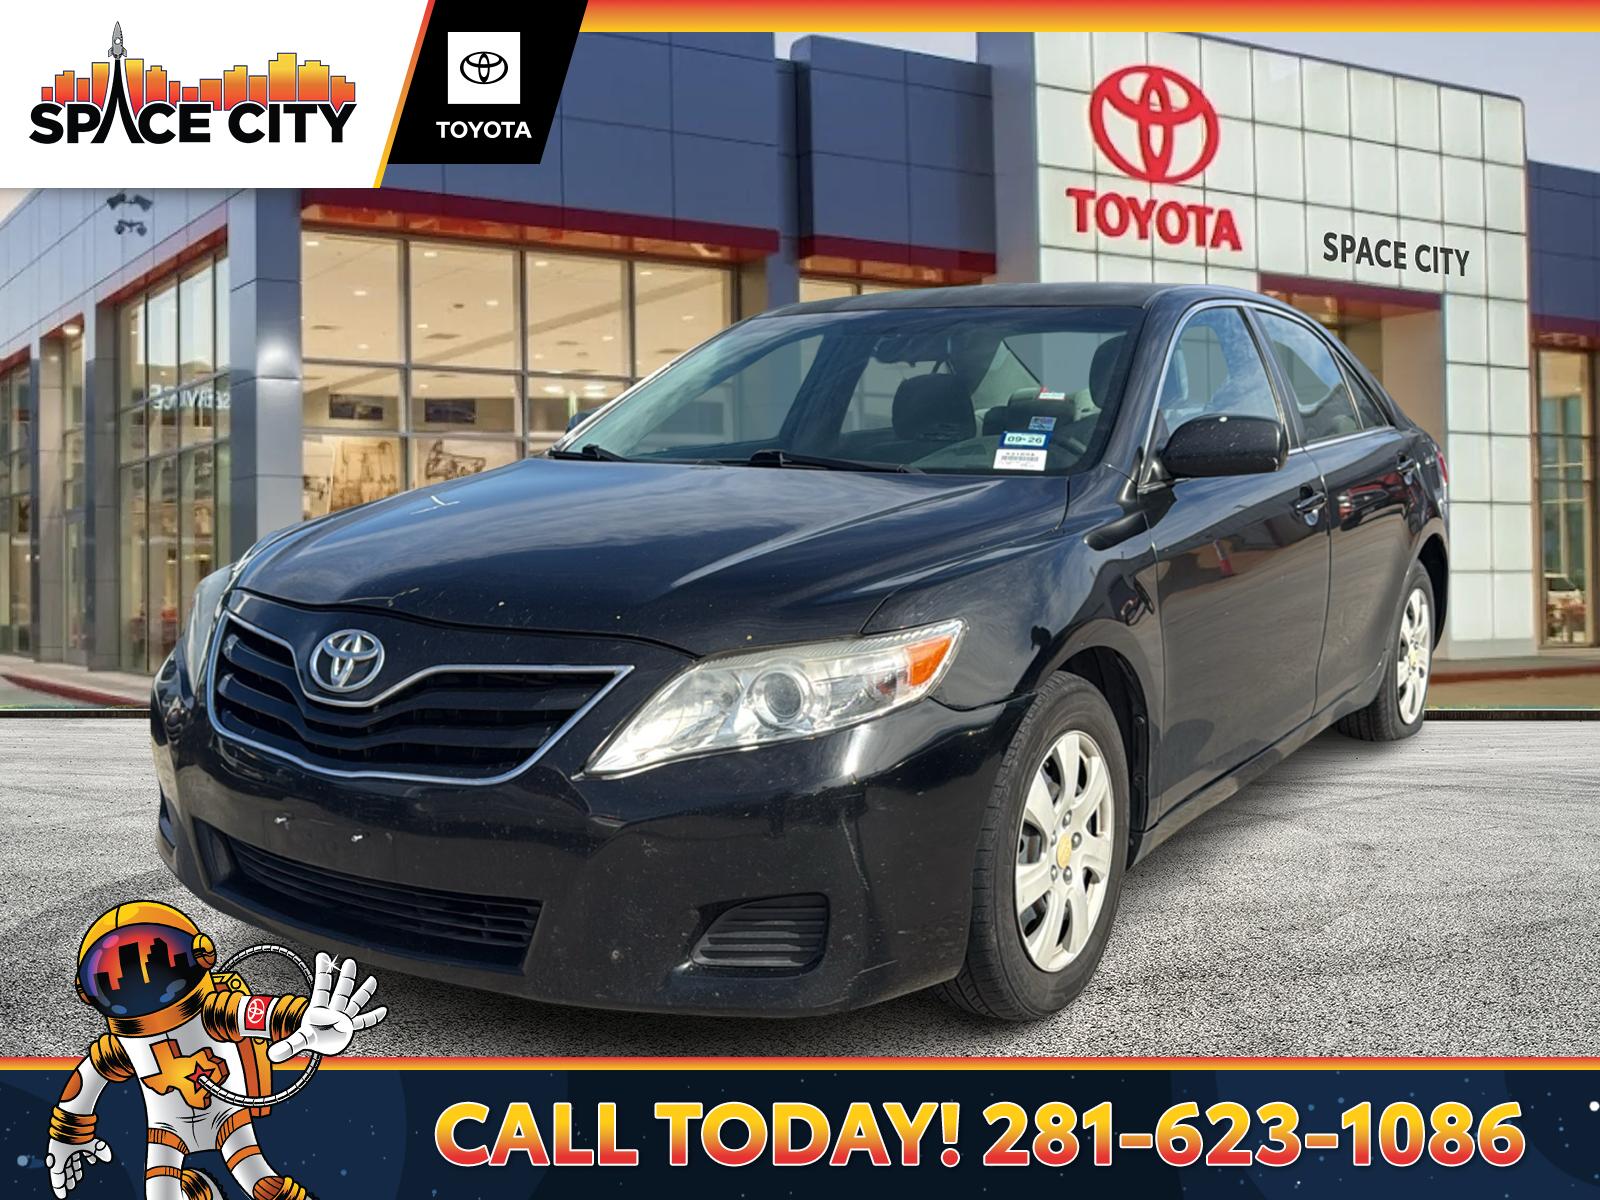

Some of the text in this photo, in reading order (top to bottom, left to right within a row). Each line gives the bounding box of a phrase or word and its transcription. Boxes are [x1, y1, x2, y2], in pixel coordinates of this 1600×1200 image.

[1066, 187, 1242, 252] TOYOTA
[1323, 232, 1470, 277] SPACE CITY
